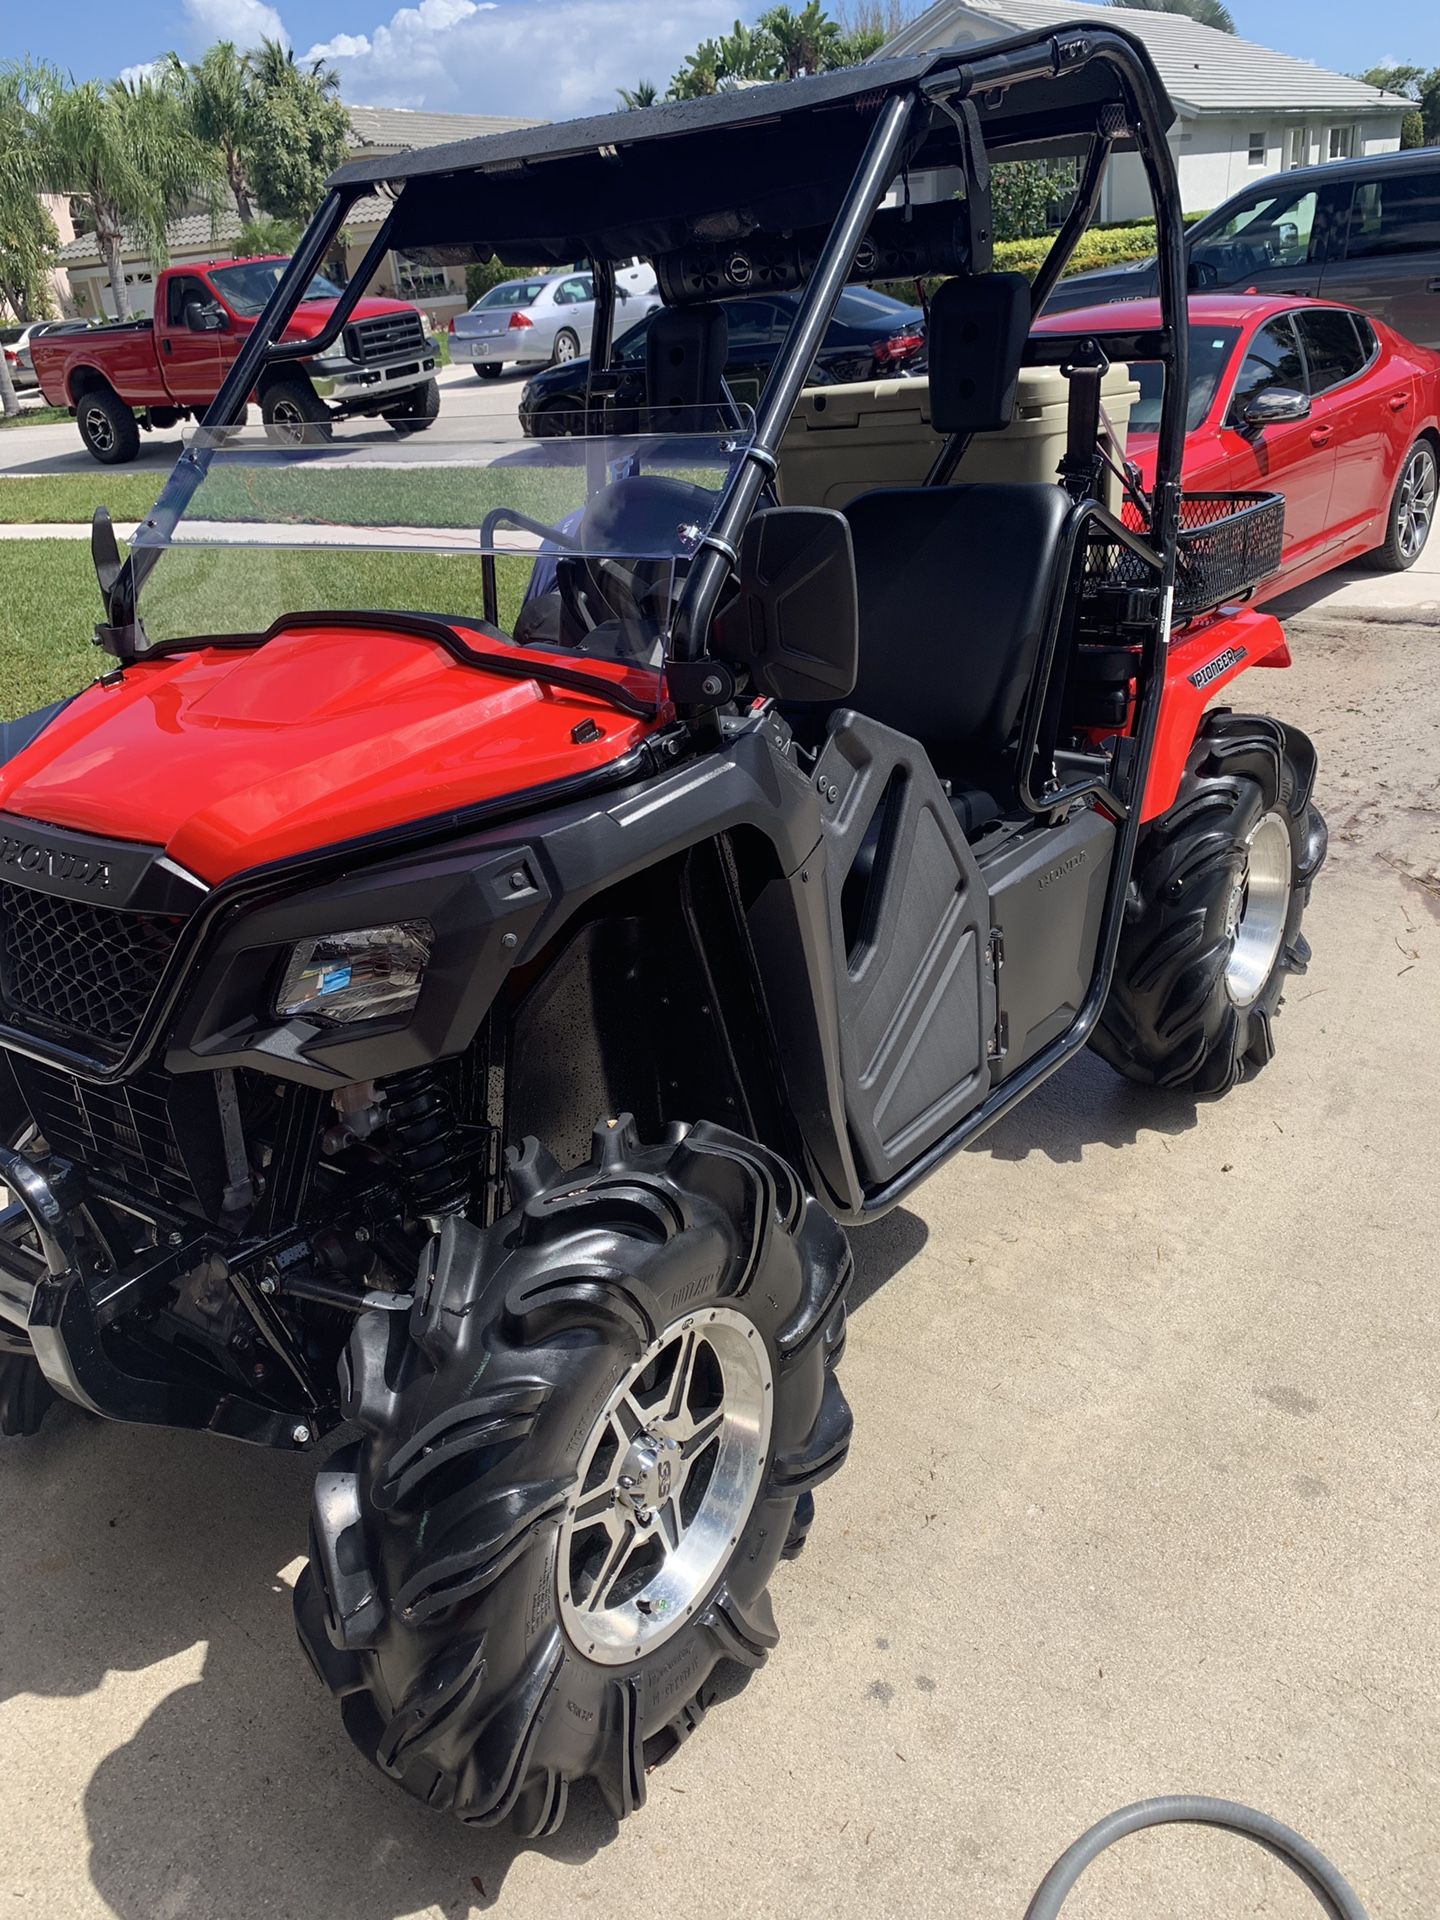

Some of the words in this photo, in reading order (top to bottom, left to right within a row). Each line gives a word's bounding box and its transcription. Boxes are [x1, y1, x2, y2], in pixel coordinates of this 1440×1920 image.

[1195, 649, 1235, 688] PIONEER
[0, 836, 112, 890] HONDA
[1038, 849, 1087, 892] HONDA
